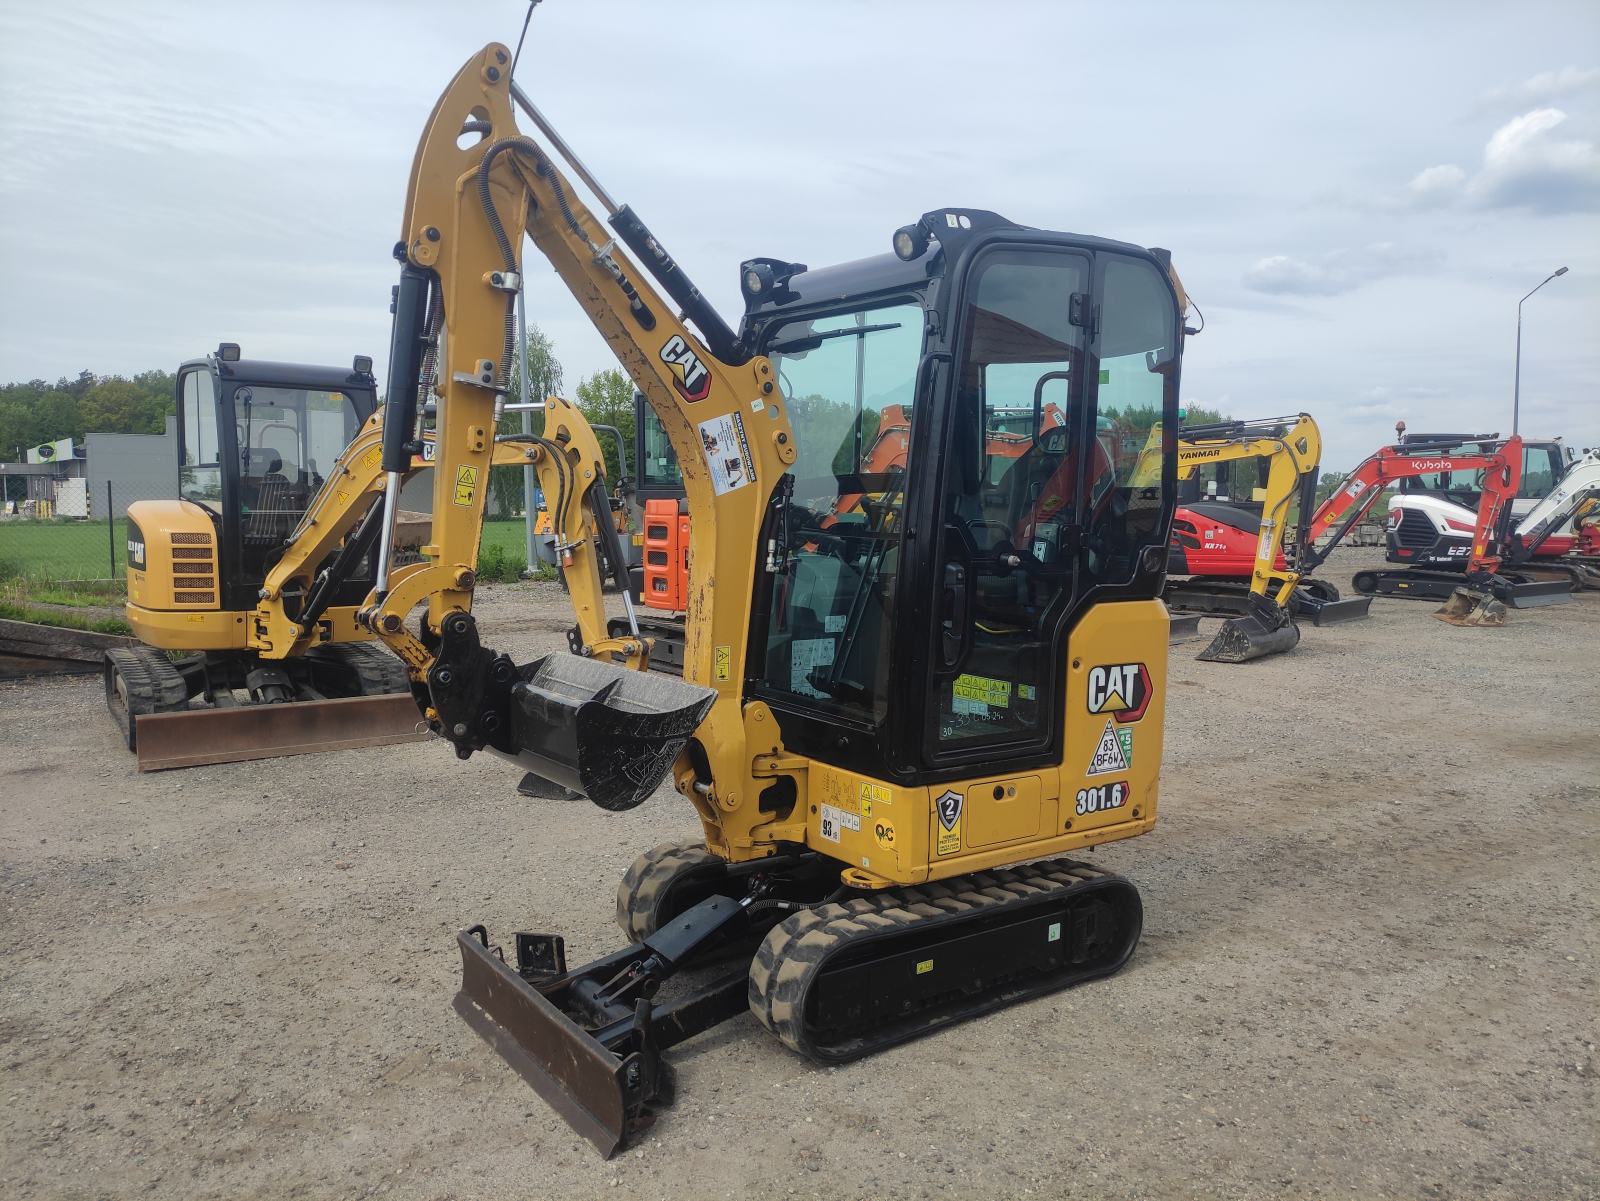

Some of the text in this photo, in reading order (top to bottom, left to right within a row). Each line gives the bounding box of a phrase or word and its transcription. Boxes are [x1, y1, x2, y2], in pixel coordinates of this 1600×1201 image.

[660, 336, 708, 389] CAT
[1179, 449, 1221, 460] YANMAR
[1412, 460, 1452, 469] Kubota
[134, 541, 145, 564] CAT
[1088, 664, 1139, 714] CAT
[1103, 738, 1114, 752] 83
[945, 799, 955, 815] 2
[1076, 783, 1122, 815] 301.6
[823, 818, 832, 837] 93
